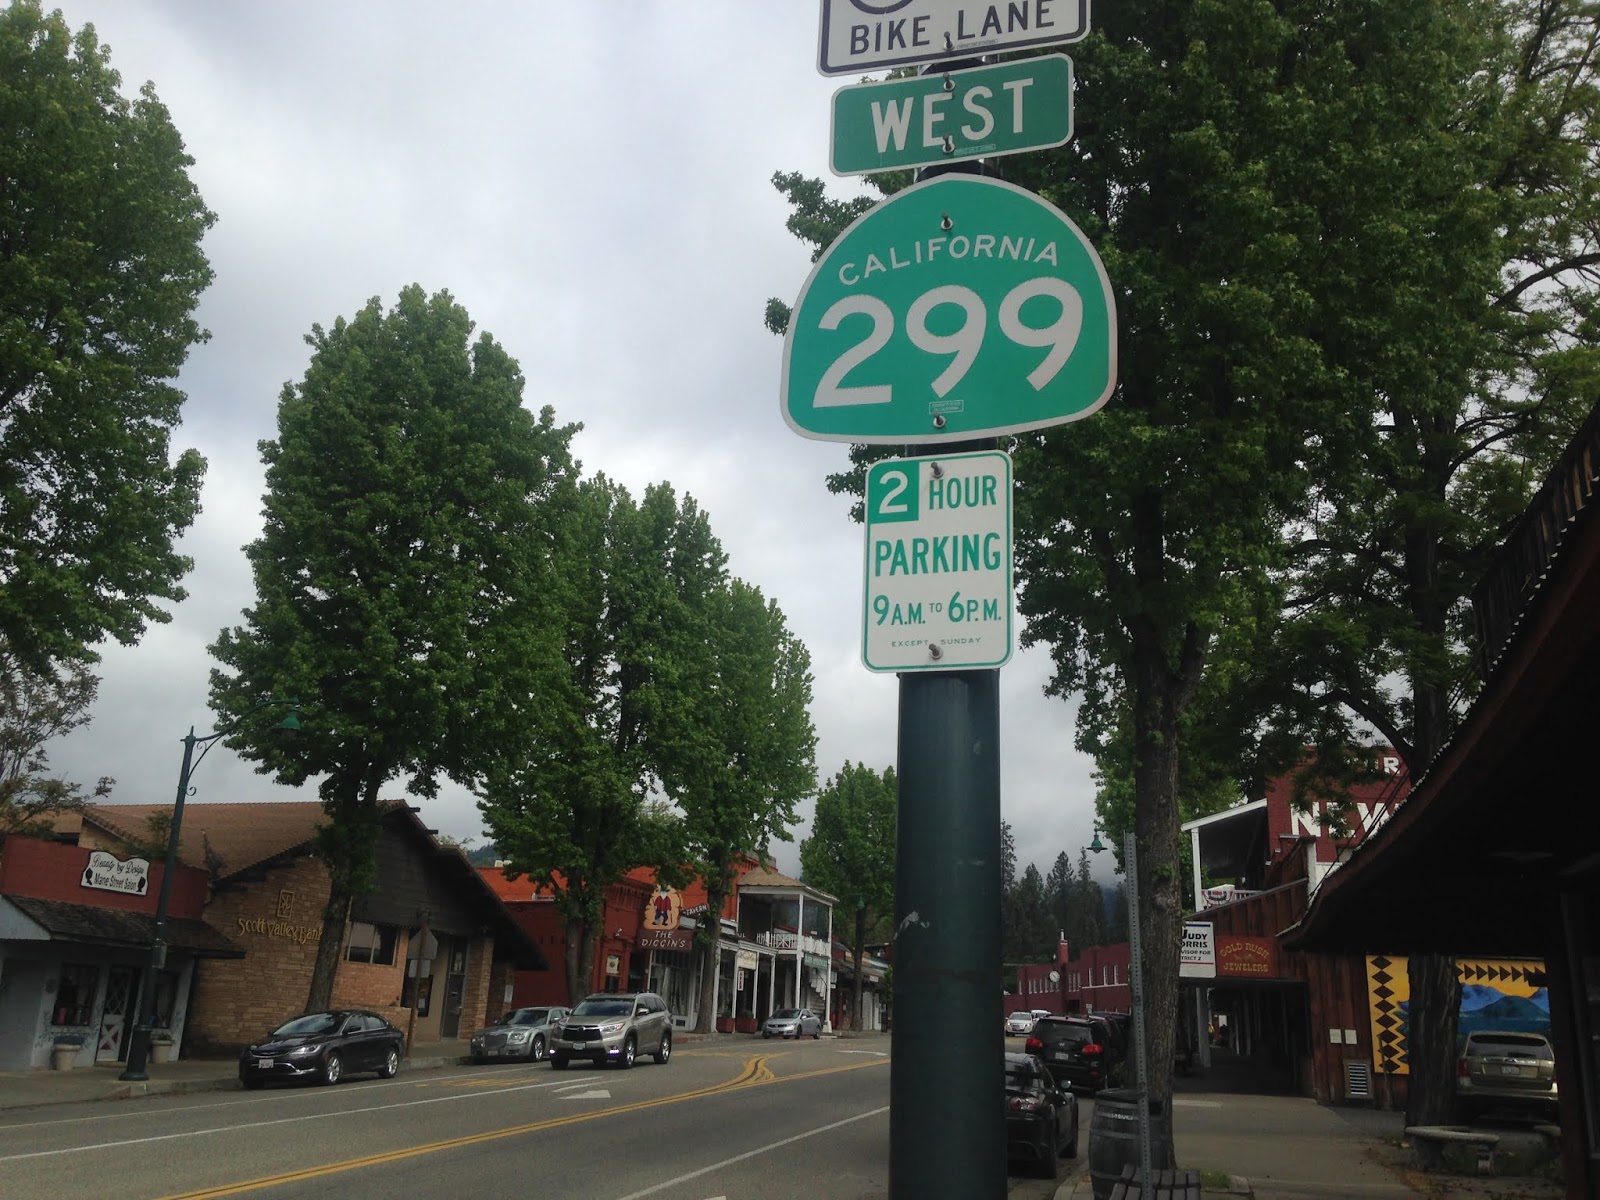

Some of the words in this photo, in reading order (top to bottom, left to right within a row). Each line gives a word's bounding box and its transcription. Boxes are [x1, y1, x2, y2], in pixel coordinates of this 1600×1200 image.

[850, 15, 931, 55] BIKE
[957, 0, 1055, 40] LANE
[871, 78, 1034, 153] WEST
[838, 234, 1058, 286] CALIFORNIA
[812, 276, 1083, 409] 299
[878, 470, 909, 514] 2
[928, 474, 997, 510] HOUR
[874, 532, 1001, 577] PARKING
[929, 602, 943, 613] TO
[891, 639, 929, 648] EXCEPT
[940, 637, 981, 645] SUNDAY
[116, 862, 125, 874] by
[109, 875, 124, 889] Street
[686, 904, 707, 916] TAVERN
[238, 918, 265, 936] Scott
[655, 930, 673, 939] THE
[1219, 942, 1243, 957] GOLD
[1245, 942, 1270, 958] RUSH
[1223, 962, 1269, 972] JEWELERS
